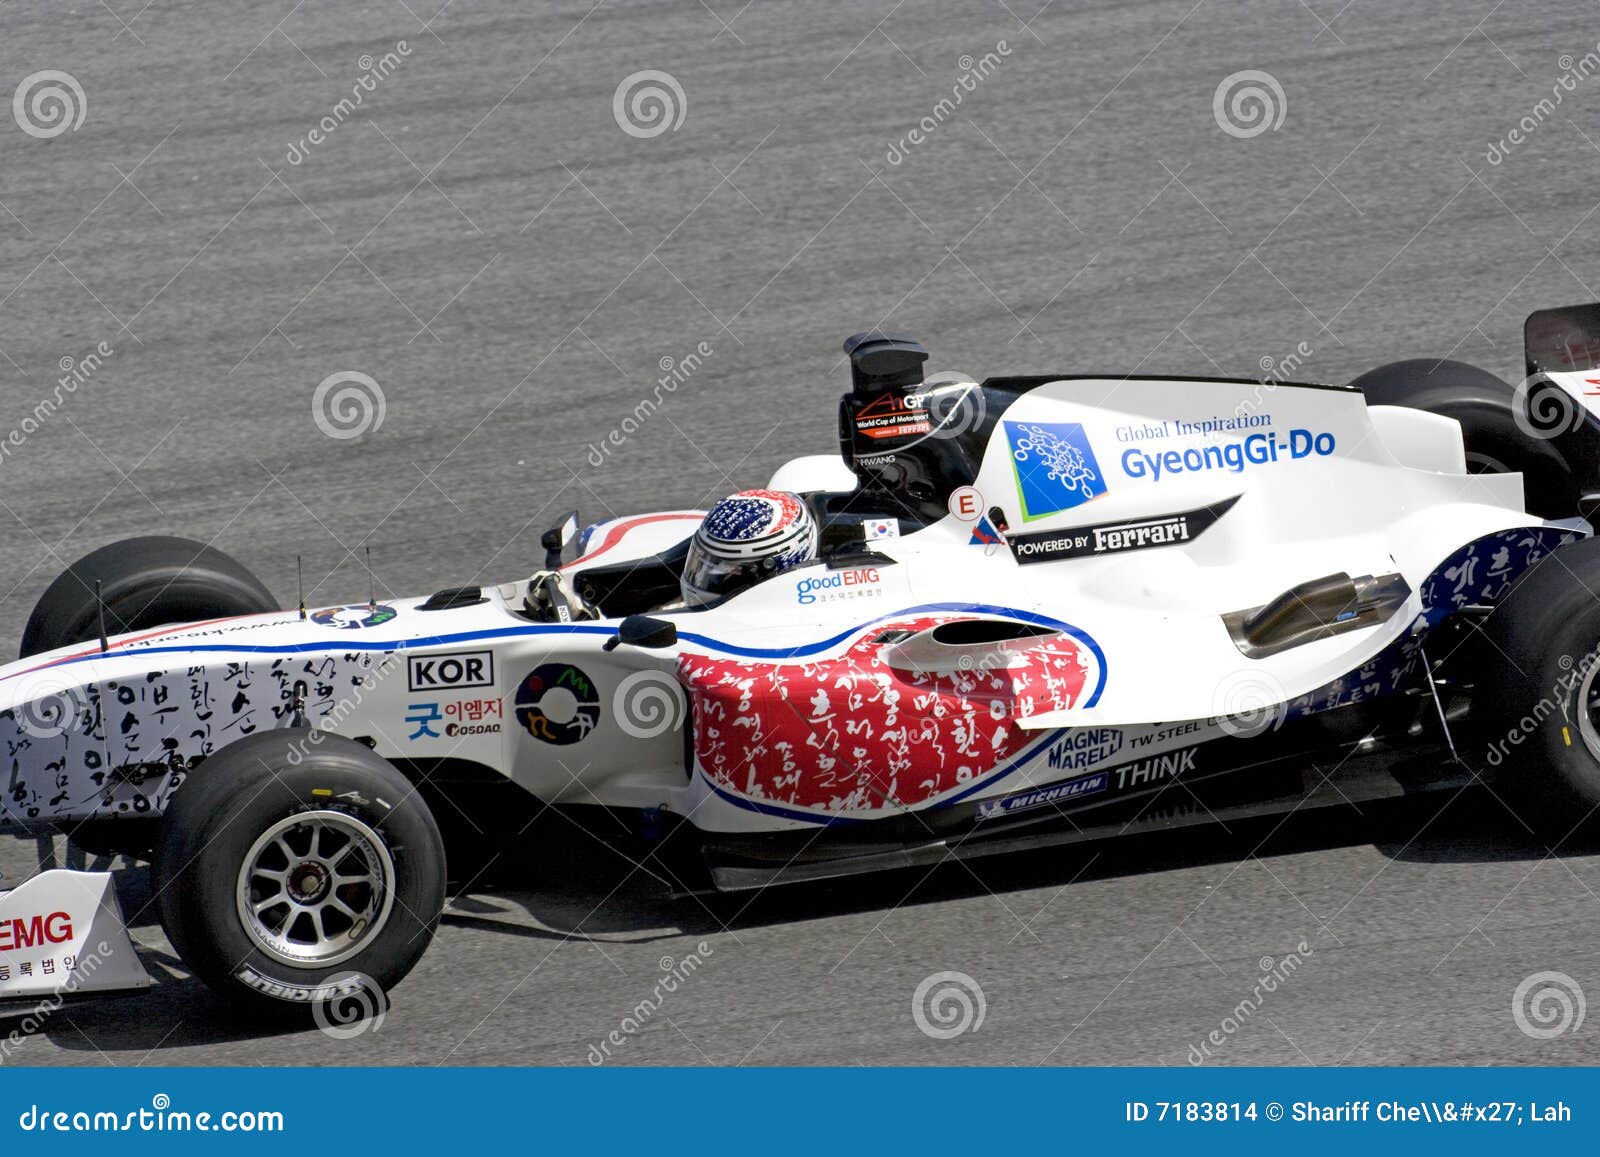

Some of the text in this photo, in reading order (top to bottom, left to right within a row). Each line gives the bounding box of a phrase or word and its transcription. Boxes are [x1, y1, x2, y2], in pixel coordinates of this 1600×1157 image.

[1116, 412, 1272, 443] Global Inspiration
[860, 455, 896, 466] HWANG
[1121, 428, 1336, 481] GyeongGi-Do
[959, 494, 976, 514] E
[1017, 516, 1190, 556] POWERED BY Ferrari
[415, 658, 485, 686] KOR
[1049, 728, 1124, 755] MAGNETI
[1130, 722, 1201, 749] TW STEEL
[1115, 747, 1200, 790] THINK
[1009, 777, 1102, 809] MICHELIN
